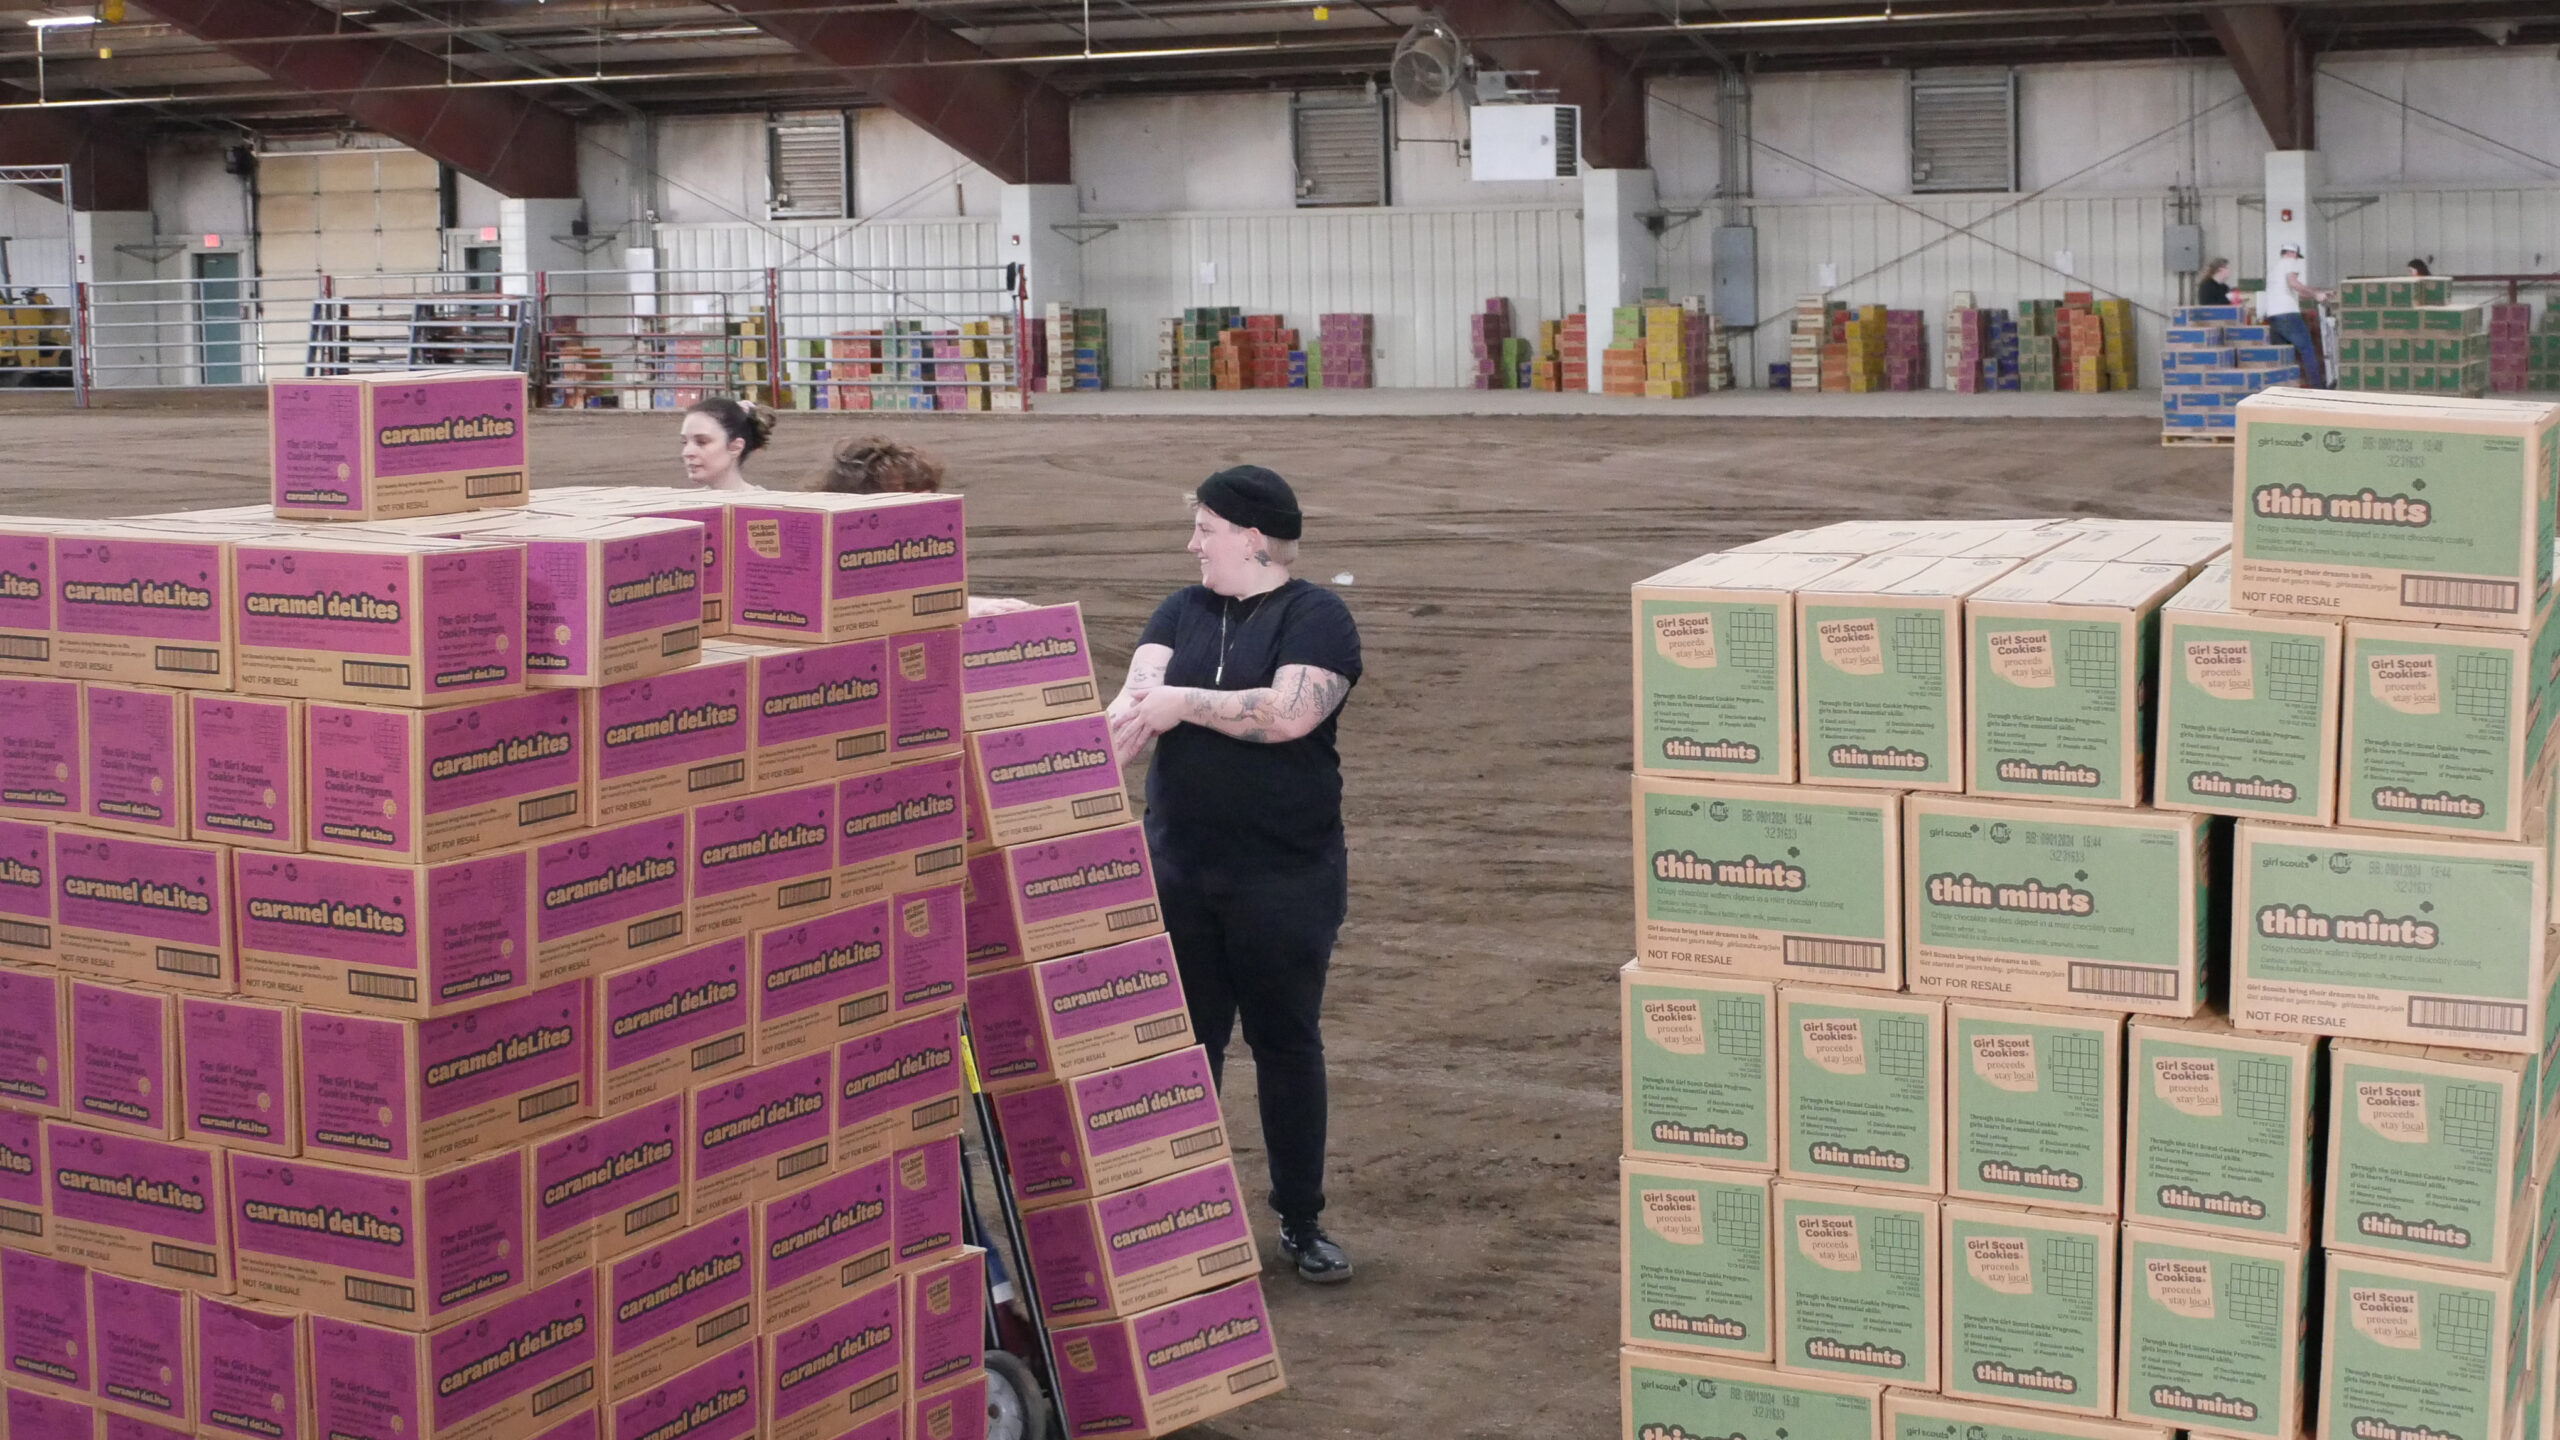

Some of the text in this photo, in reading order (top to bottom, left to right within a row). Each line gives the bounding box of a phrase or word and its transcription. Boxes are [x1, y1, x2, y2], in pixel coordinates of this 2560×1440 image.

[380, 416, 514, 445] caramel deLites
[2256, 486, 2428, 524] thin mints
[839, 536, 955, 569] caramel deLites
[64, 580, 209, 607] caramel deLites
[247, 593, 398, 620] caramel deLites
[2242, 591, 2341, 608] NOT FOR RESALE
[1656, 617, 1709, 629] Girl Scout
[1668, 638, 1705, 650] proceeds
[1676, 648, 1713, 659] stay local
[1991, 634, 2047, 646] Girl Scout
[2004, 656, 2042, 668] proceeds
[2011, 666, 2052, 678] stay local
[2371, 660, 2433, 669] Girl Scout
[2385, 682, 2427, 693] proceeds
[2393, 693, 2436, 704] stay local
[606, 704, 737, 745] caramel deLites
[432, 733, 569, 778] caramel deLites
[1664, 739, 1758, 762] thin mints
[1830, 747, 1926, 769] thin mints
[990, 749, 1107, 782] caramel deLites
[1998, 761, 2098, 785] thin mints
[2190, 773, 2294, 801] thin mints
[846, 795, 954, 834] caramel deLites
[2374, 789, 2483, 816] thin mints
[0, 861, 41, 884] Lites
[546, 859, 676, 906] caramel deLites
[1654, 853, 1803, 889] thin mints
[65, 878, 209, 912] caramel deLites
[1929, 876, 2091, 914] thin mints
[250, 900, 404, 933] caramel deLites
[2260, 907, 2436, 946] thin mints
[1647, 949, 1733, 966] NOT FOR RESALE
[1053, 971, 1169, 1012] caramel deLites
[1919, 975, 2012, 992] NOT FOR RESALE
[1803, 1022, 1858, 1032] Girl Scout
[2246, 1010, 2347, 1028] NOT FOR RESALE
[427, 1027, 571, 1085] caramel deLites
[1816, 1044, 1853, 1053] proceeds
[1823, 1053, 1862, 1064] stay local
[1653, 1123, 1746, 1148] thin mints
[1811, 1144, 1907, 1171] thin mints
[1981, 1162, 2081, 1190] thin mints
[59, 1170, 203, 1211] caramel deLites
[2160, 1187, 2264, 1218] thin mints
[246, 1202, 402, 1243] caramel deLites
[1112, 1200, 1232, 1249] caramel deLites
[2360, 1214, 2468, 1247] thin mints
[2148, 1263, 2207, 1273] Girl Scout
[619, 1254, 742, 1320] caramel deLites
[2162, 1286, 2201, 1295] proceeds
[2169, 1297, 2211, 1308] stay local
[1652, 1311, 1744, 1338] thin mints
[440, 1316, 584, 1394] caramel deLites
[1808, 1339, 1904, 1368] thin mints
[1975, 1363, 2075, 1393] thin mints
[2152, 1387, 2256, 1420] thin mints
[2355, 1419, 2397, 1440] thin
